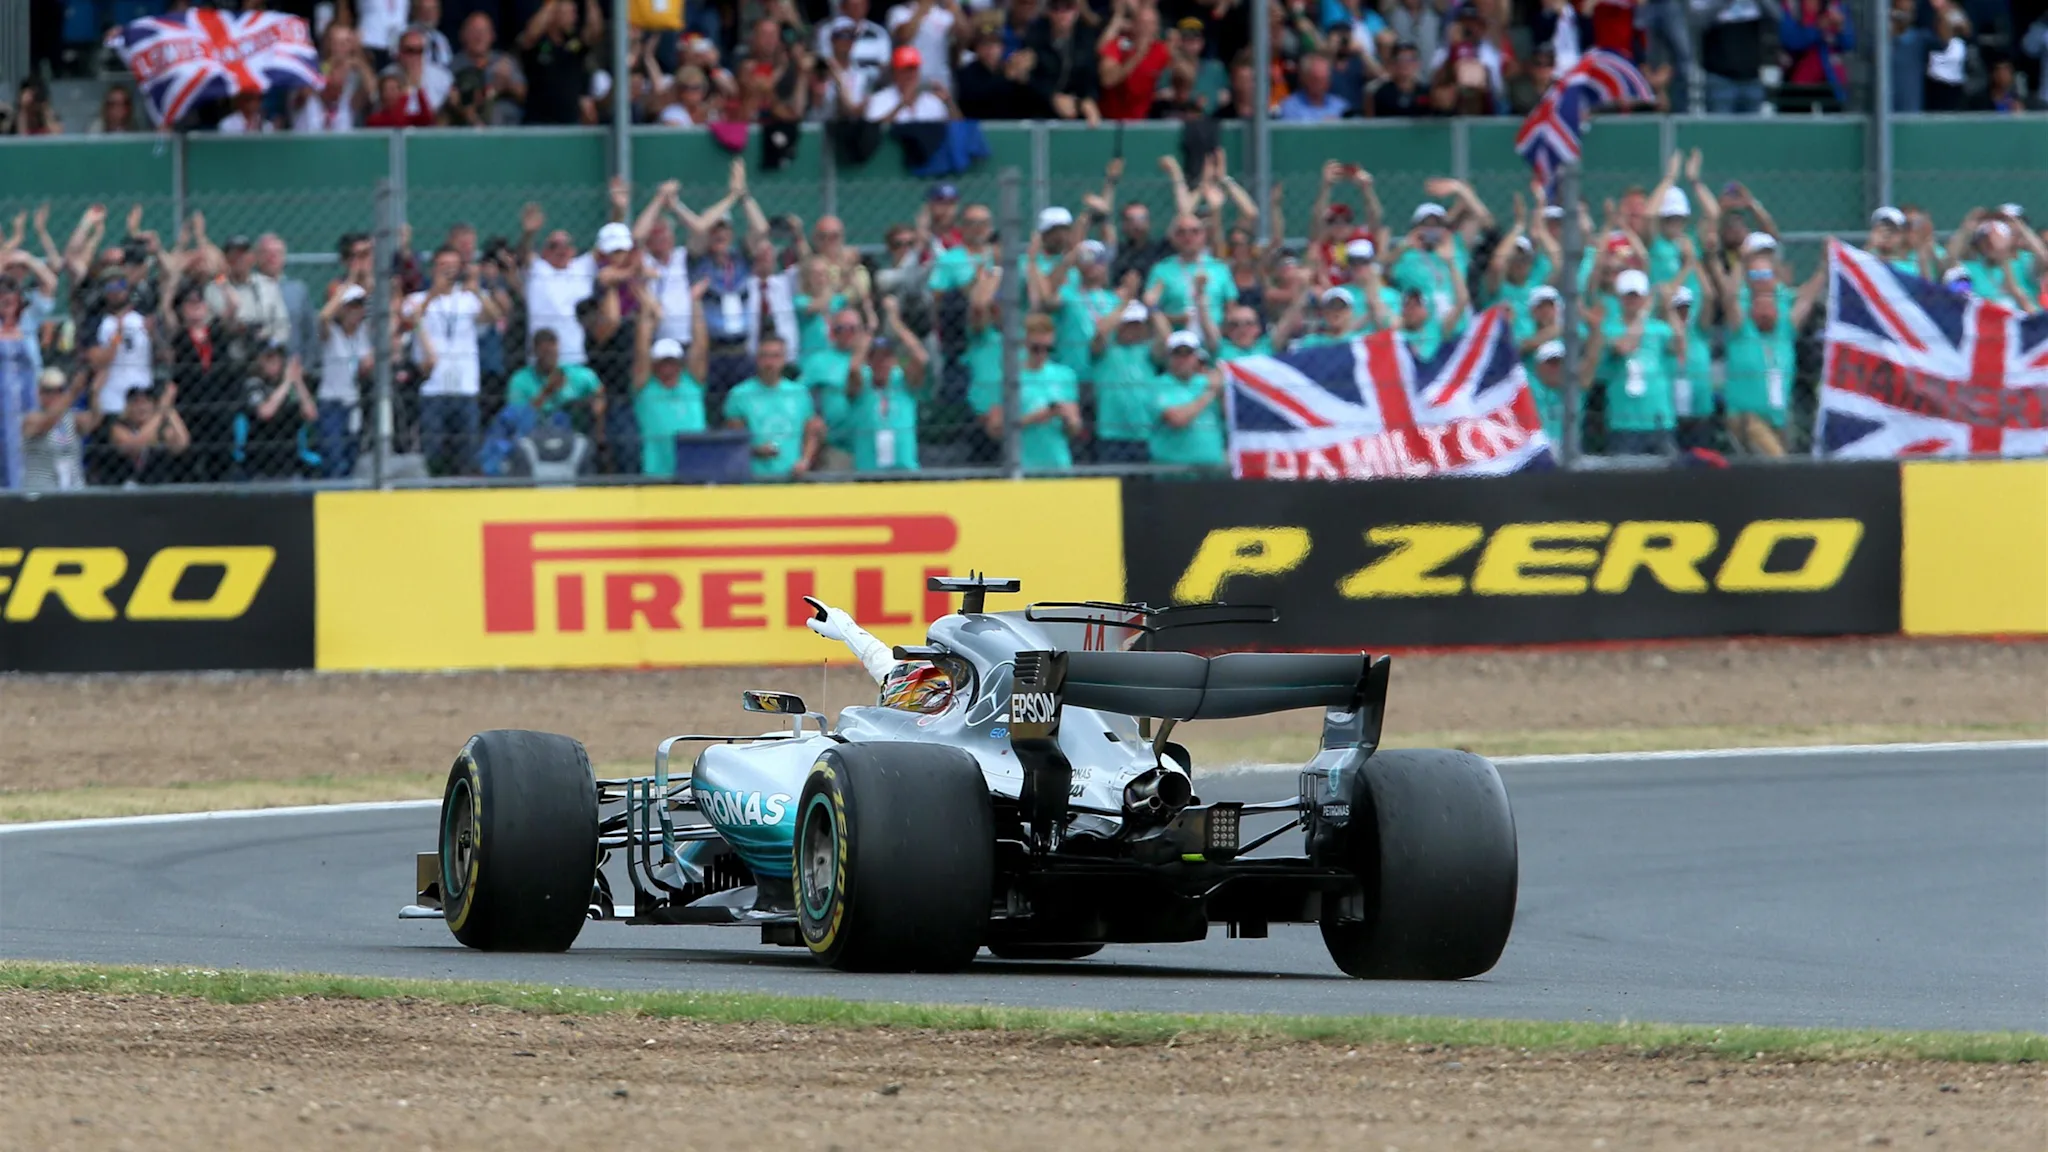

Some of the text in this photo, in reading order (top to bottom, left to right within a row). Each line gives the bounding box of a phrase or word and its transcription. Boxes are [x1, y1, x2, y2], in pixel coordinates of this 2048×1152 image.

[1263, 404, 1532, 480] HAMILTON
[0, 546, 276, 621] RO
[482, 514, 957, 633] PIRELLI
[1170, 518, 1865, 604] P ZERO
[1012, 692, 1055, 723] EPSON
[1322, 804, 1350, 817] PETRONAS
